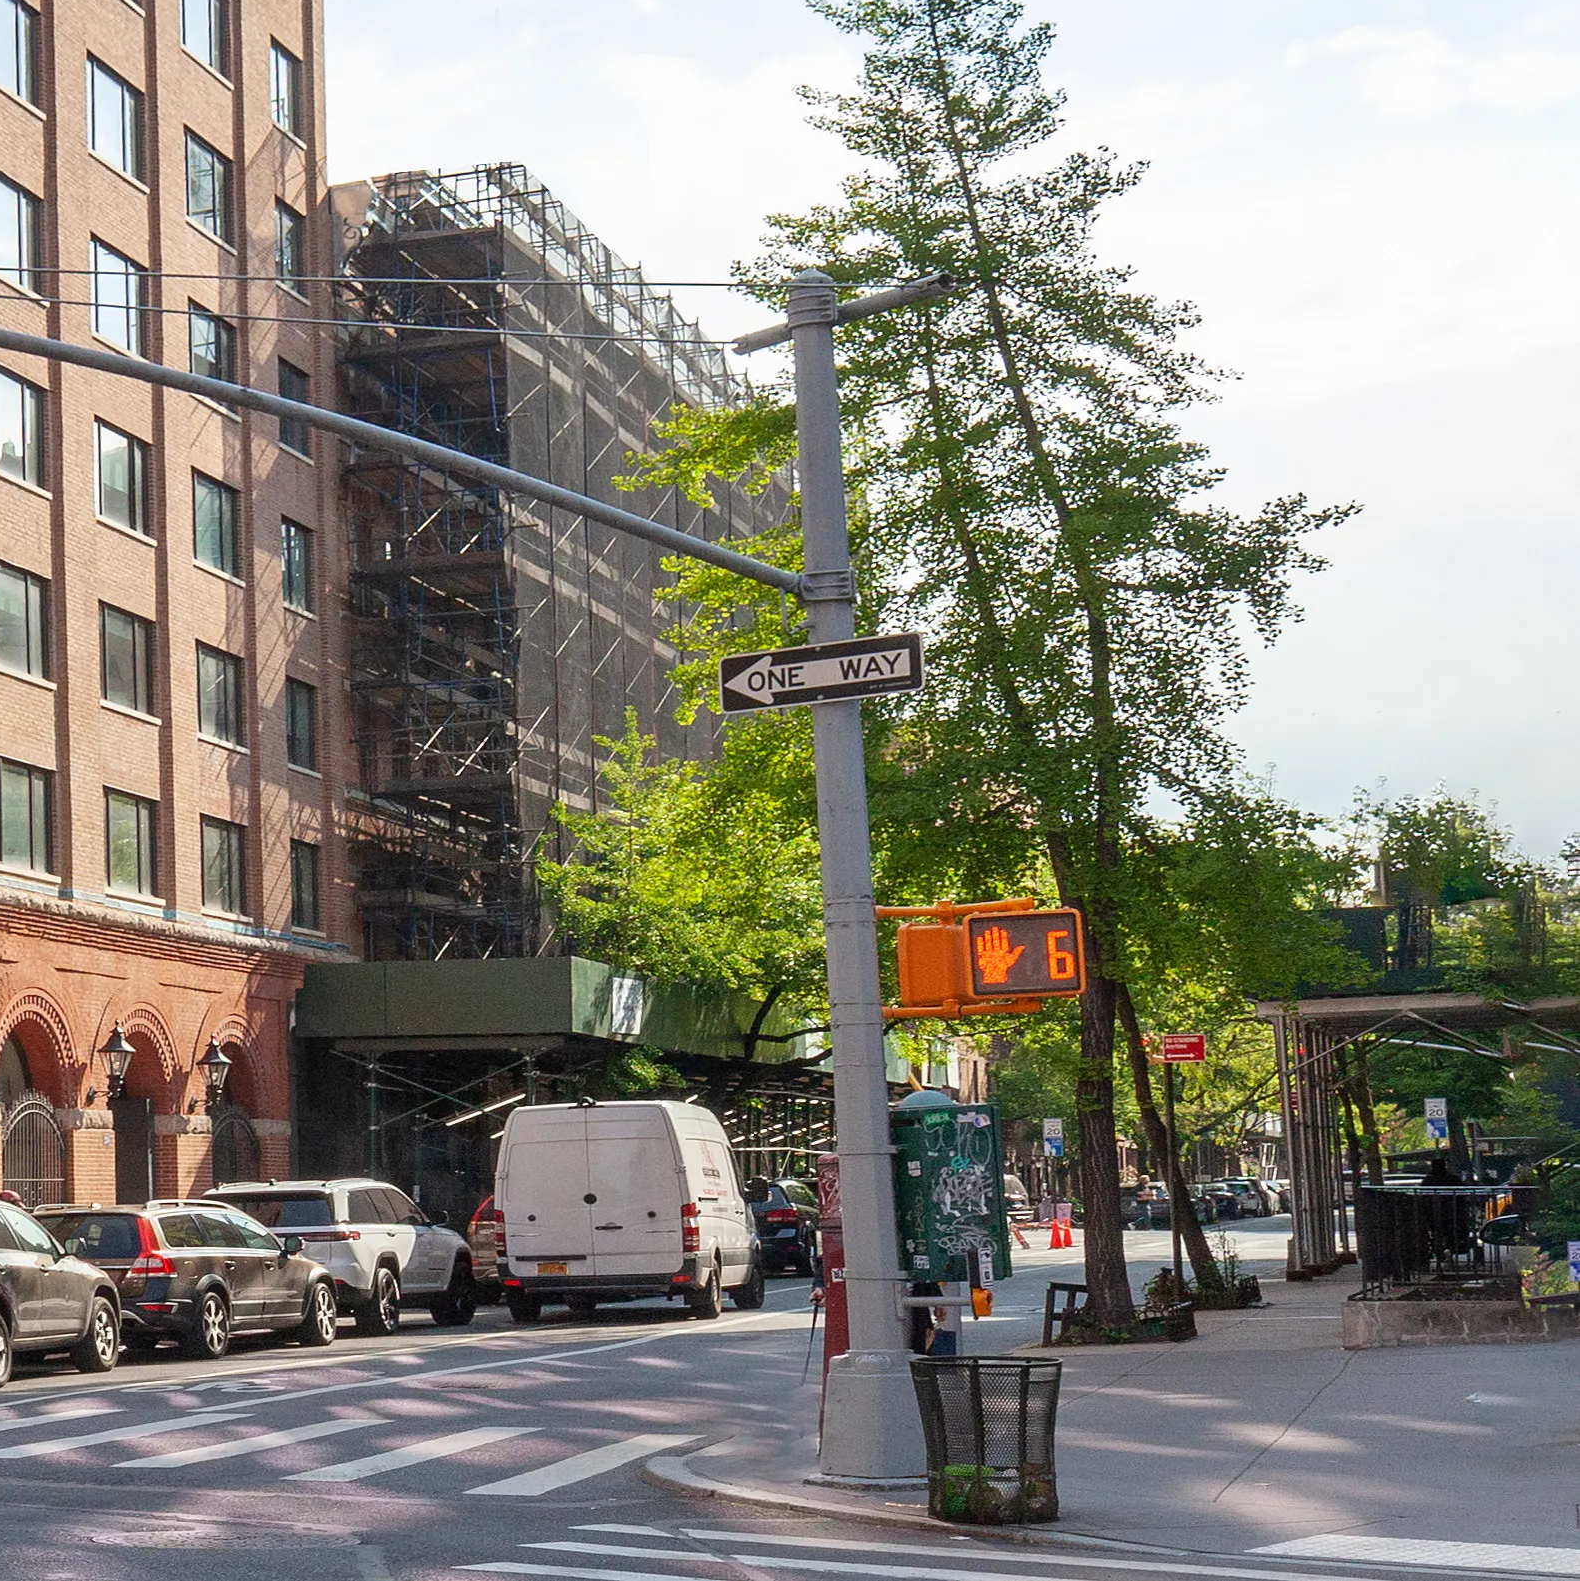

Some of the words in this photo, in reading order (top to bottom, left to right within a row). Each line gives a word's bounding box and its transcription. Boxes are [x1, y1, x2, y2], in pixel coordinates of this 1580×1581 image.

[747, 665, 805, 692] ONE
[839, 651, 903, 681] WAY
[1046, 930, 1076, 980] 6
[1431, 1109, 1444, 1117] 20
[1047, 1127, 1060, 1136] 20
